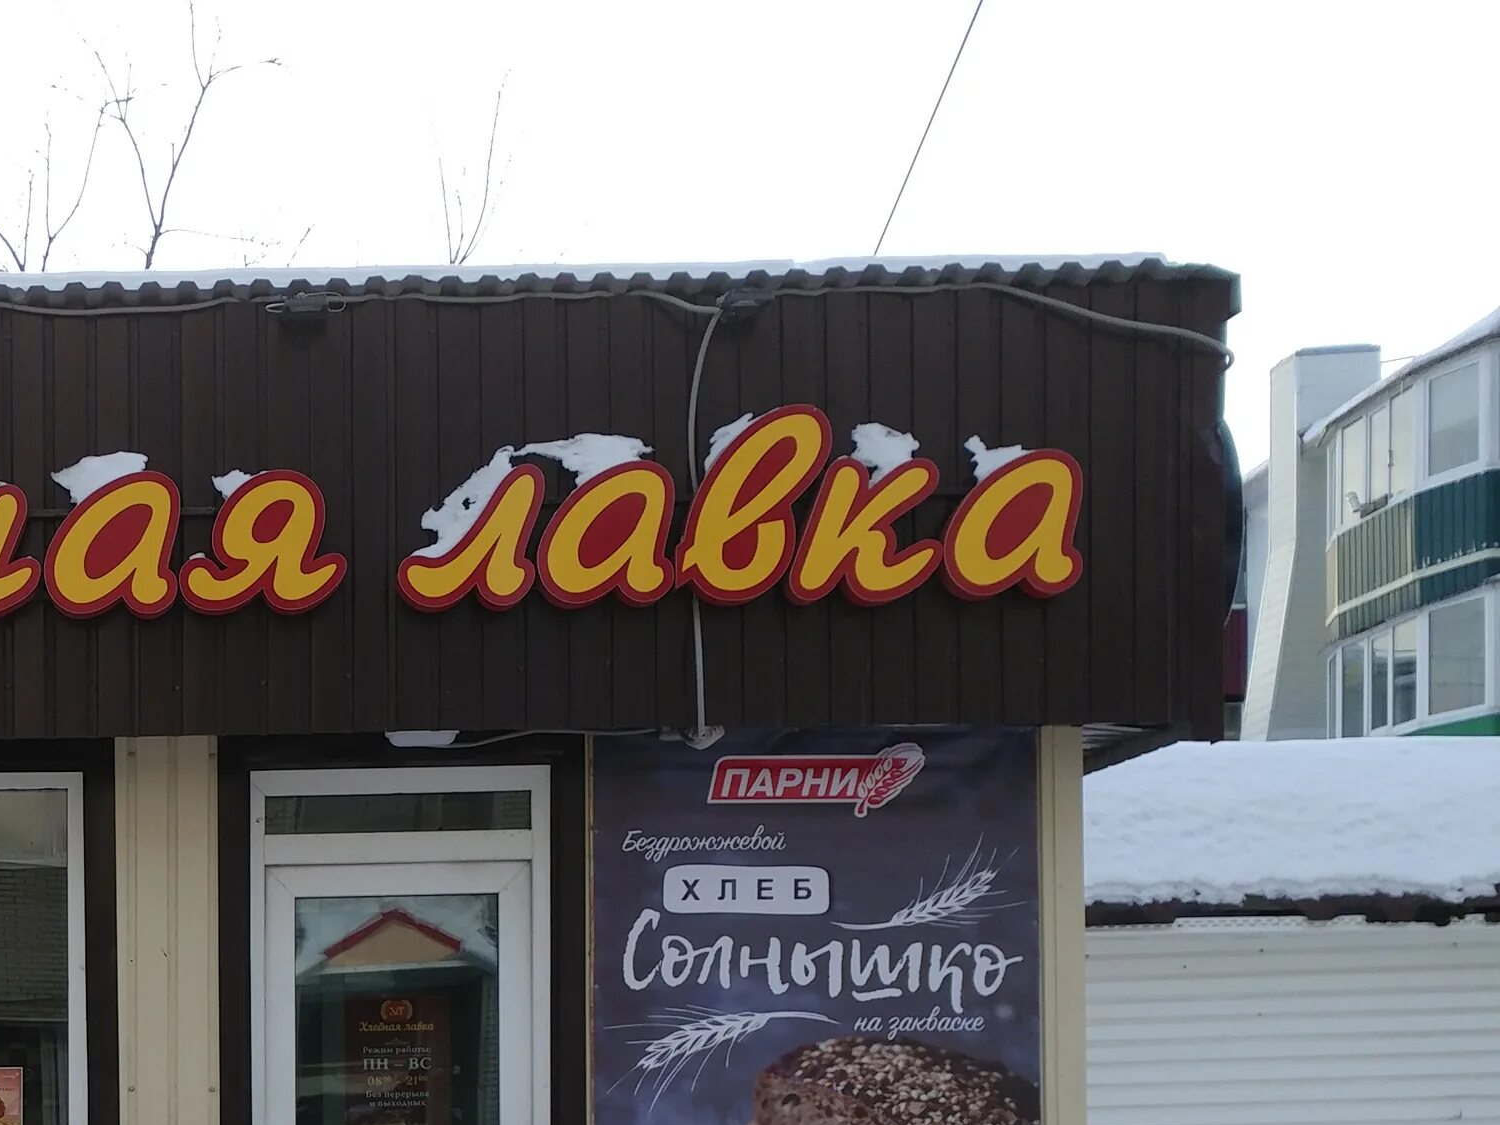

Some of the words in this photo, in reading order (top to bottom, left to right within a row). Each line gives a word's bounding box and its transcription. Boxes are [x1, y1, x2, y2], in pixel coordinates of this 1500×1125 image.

[397, 404, 1083, 612] лавка
[719, 767, 859, 799] ПАРНИ
[621, 824, 787, 862] Бездрожжевой
[681, 878, 813, 901] ХЛЕБ
[622, 908, 1024, 1013] Солнышко
[359, 1021, 401, 1032] Хлебная
[403, 1021, 434, 1032] лавка
[853, 1013, 883, 1032] на
[887, 1006, 985, 1040] закваске
[362, 1046, 393, 1054] Режим
[363, 1058, 389, 1070] ПН
[408, 1057, 432, 1070] ВС
